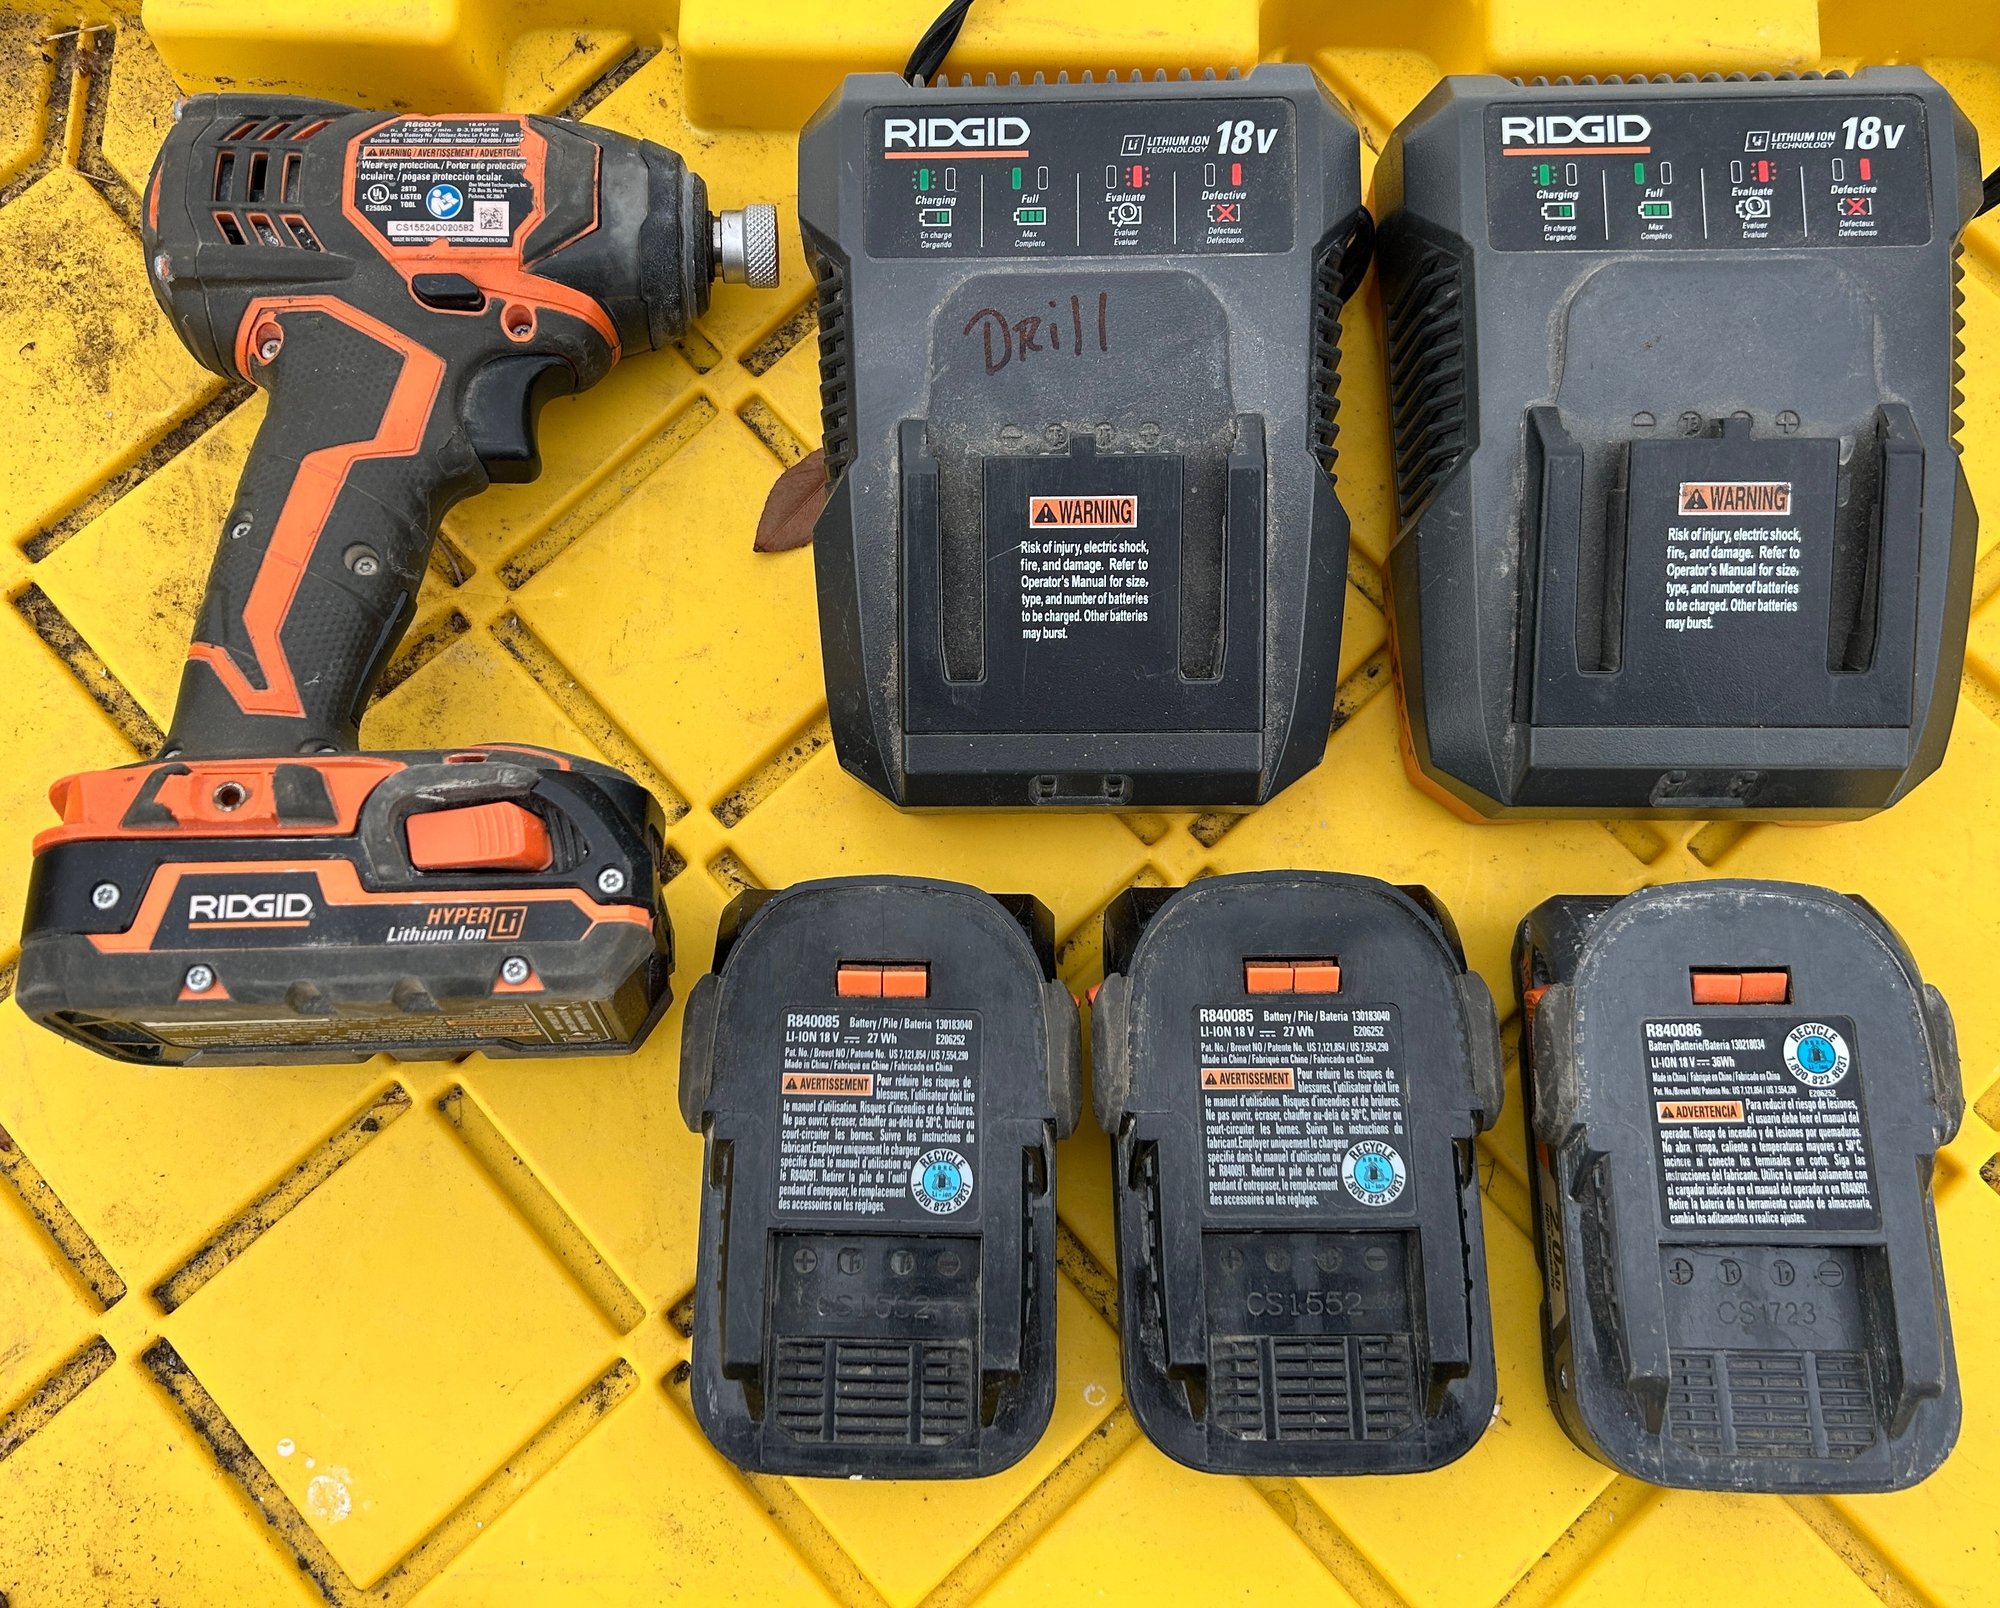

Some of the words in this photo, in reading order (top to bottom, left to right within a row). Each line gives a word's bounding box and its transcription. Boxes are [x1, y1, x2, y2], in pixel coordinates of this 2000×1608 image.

[885, 118, 1031, 147] RIDGID
[1502, 115, 1652, 144] RIDGID
[1772, 133, 1815, 142] LITHIUM
[1817, 132, 1836, 141] ION
[1128, 138, 1139, 150] Li
[1147, 136, 1189, 146] LITHIUM
[1191, 136, 1210, 145] ION
[1147, 146, 1207, 154] TECHNOLOGY
[379, 149, 412, 157] WARNING
[418, 149, 474, 157] AVERTISSEMENT
[362, 161, 383, 169] Wear
[384, 162, 398, 171] eye
[399, 161, 440, 170] protection.
[447, 161, 469, 169] Porter
[361, 172, 395, 181] oculaire.
[433, 173, 475, 182] protección
[1202, 191, 1246, 200] Defective
[1537, 190, 1579, 200] Charging
[1645, 189, 1663, 198] Full
[1731, 187, 1773, 196] Evaluate
[1831, 185, 1877, 194] Defective
[916, 196, 956, 206] Charging
[1022, 194, 1039, 203] Full
[1106, 193, 1145, 202] Evaluate
[1710, 487, 1786, 510] WARNING
[1059, 500, 1131, 523] WARNING
[1668, 528, 1689, 541] Risk
[1691, 528, 1701, 541] of
[1702, 528, 1731, 544] injury,
[1734, 528, 1768, 541] electric
[1770, 528, 1801, 543] shock,
[1021, 541, 1041, 553] Risk
[1043, 541, 1052, 553] of
[1054, 541, 1082, 556] injury,
[1084, 540, 1117, 553] electric
[1119, 540, 1149, 554] shock,
[1667, 546, 1687, 561] fire,
[1690, 546, 1709, 559] and
[1711, 546, 1753, 562] damage.
[1760, 546, 1787, 559] Refer
[1789, 548, 1799, 558] to
[1021, 558, 1040, 572] fire,
[1042, 559, 1061, 571] and
[1063, 559, 1104, 573] damage.
[1110, 558, 1135, 570] Refer
[1138, 560, 1148, 570] to
[1720, 563, 1756, 576] Manual
[1759, 563, 1772, 576] for
[1776, 564, 1798, 576] size,
[1021, 575, 1069, 590] Operator's
[1072, 575, 1106, 587] Manual
[1110, 575, 1122, 587] for
[1126, 575, 1148, 588] size,
[1667, 582, 1689, 596] type,
[1691, 581, 1708, 594] and
[1711, 581, 1745, 594] number
[1746, 580, 1756, 593] of
[1757, 581, 1798, 594] batteries
[1022, 593, 1043, 607] type,
[1045, 593, 1062, 605] and
[1064, 593, 1096, 605] number
[1098, 592, 1107, 605] of
[1109, 593, 1148, 605] batteries
[1666, 600, 1675, 611] to
[1677, 599, 1687, 611] be
[1689, 599, 1728, 614] charged.
[1731, 599, 1757, 611] Other
[1758, 599, 1797, 611] batteries
[1022, 611, 1031, 622] to
[1033, 610, 1042, 621] be
[1044, 610, 1082, 624] charged.
[1084, 609, 1108, 621] Other
[1110, 610, 1148, 621] batteries
[1666, 617, 1685, 632] may
[1687, 616, 1713, 629] burst.
[1023, 628, 1041, 642] may
[1043, 627, 1067, 639] burst.
[188, 894, 313, 920] RIDGID
[427, 907, 491, 925] HYPER
[497, 912, 517, 933] Li
[387, 926, 453, 942] Lithium
[458, 925, 486, 941] Ion
[787, 1014, 839, 1027] R840085
[850, 1019, 877, 1030] Battery
[884, 1019, 898, 1030] Pile
[936, 1019, 972, 1030] 130183040
[1200, 1009, 1253, 1022] R840085
[1264, 1011, 1291, 1023] Battery
[1298, 1011, 1313, 1021] Pile
[1352, 1010, 1390, 1021] 130183040
[786, 1031, 817, 1043] LI-ION
[820, 1032, 830, 1042] 18
[832, 1032, 839, 1042] V
[867, 1033, 878, 1043] 27
[881, 1033, 897, 1044] Wh
[936, 1034, 965, 1045] E206252
[1201, 1026, 1232, 1037] LI-ION
[1234, 1026, 1245, 1037] 18
[1246, 1026, 1254, 1037] V
[1283, 1026, 1294, 1037] 27
[1297, 1026, 1314, 1037] Wh
[1354, 1026, 1384, 1037] E206252
[1646, 1024, 1702, 1037] R840086
[1789, 1024, 1838, 1042] RECYCLE
[1651, 1057, 1677, 1068] LI-ION
[1678, 1057, 1688, 1067] 18
[1712, 1057, 1735, 1067] 36Wh
[800, 1079, 869, 1090] AVERTISSEMENT
[1220, 1073, 1289, 1085] AVERTISSEMENT
[1676, 1105, 1737, 1119] ADVERTENCIA
[1349, 1142, 1396, 1159] RECYCLE
[920, 1150, 965, 1168] RECYCLE
[1247, 1292, 1364, 1316] CS1552
[1718, 1301, 1816, 1325] CS1723
